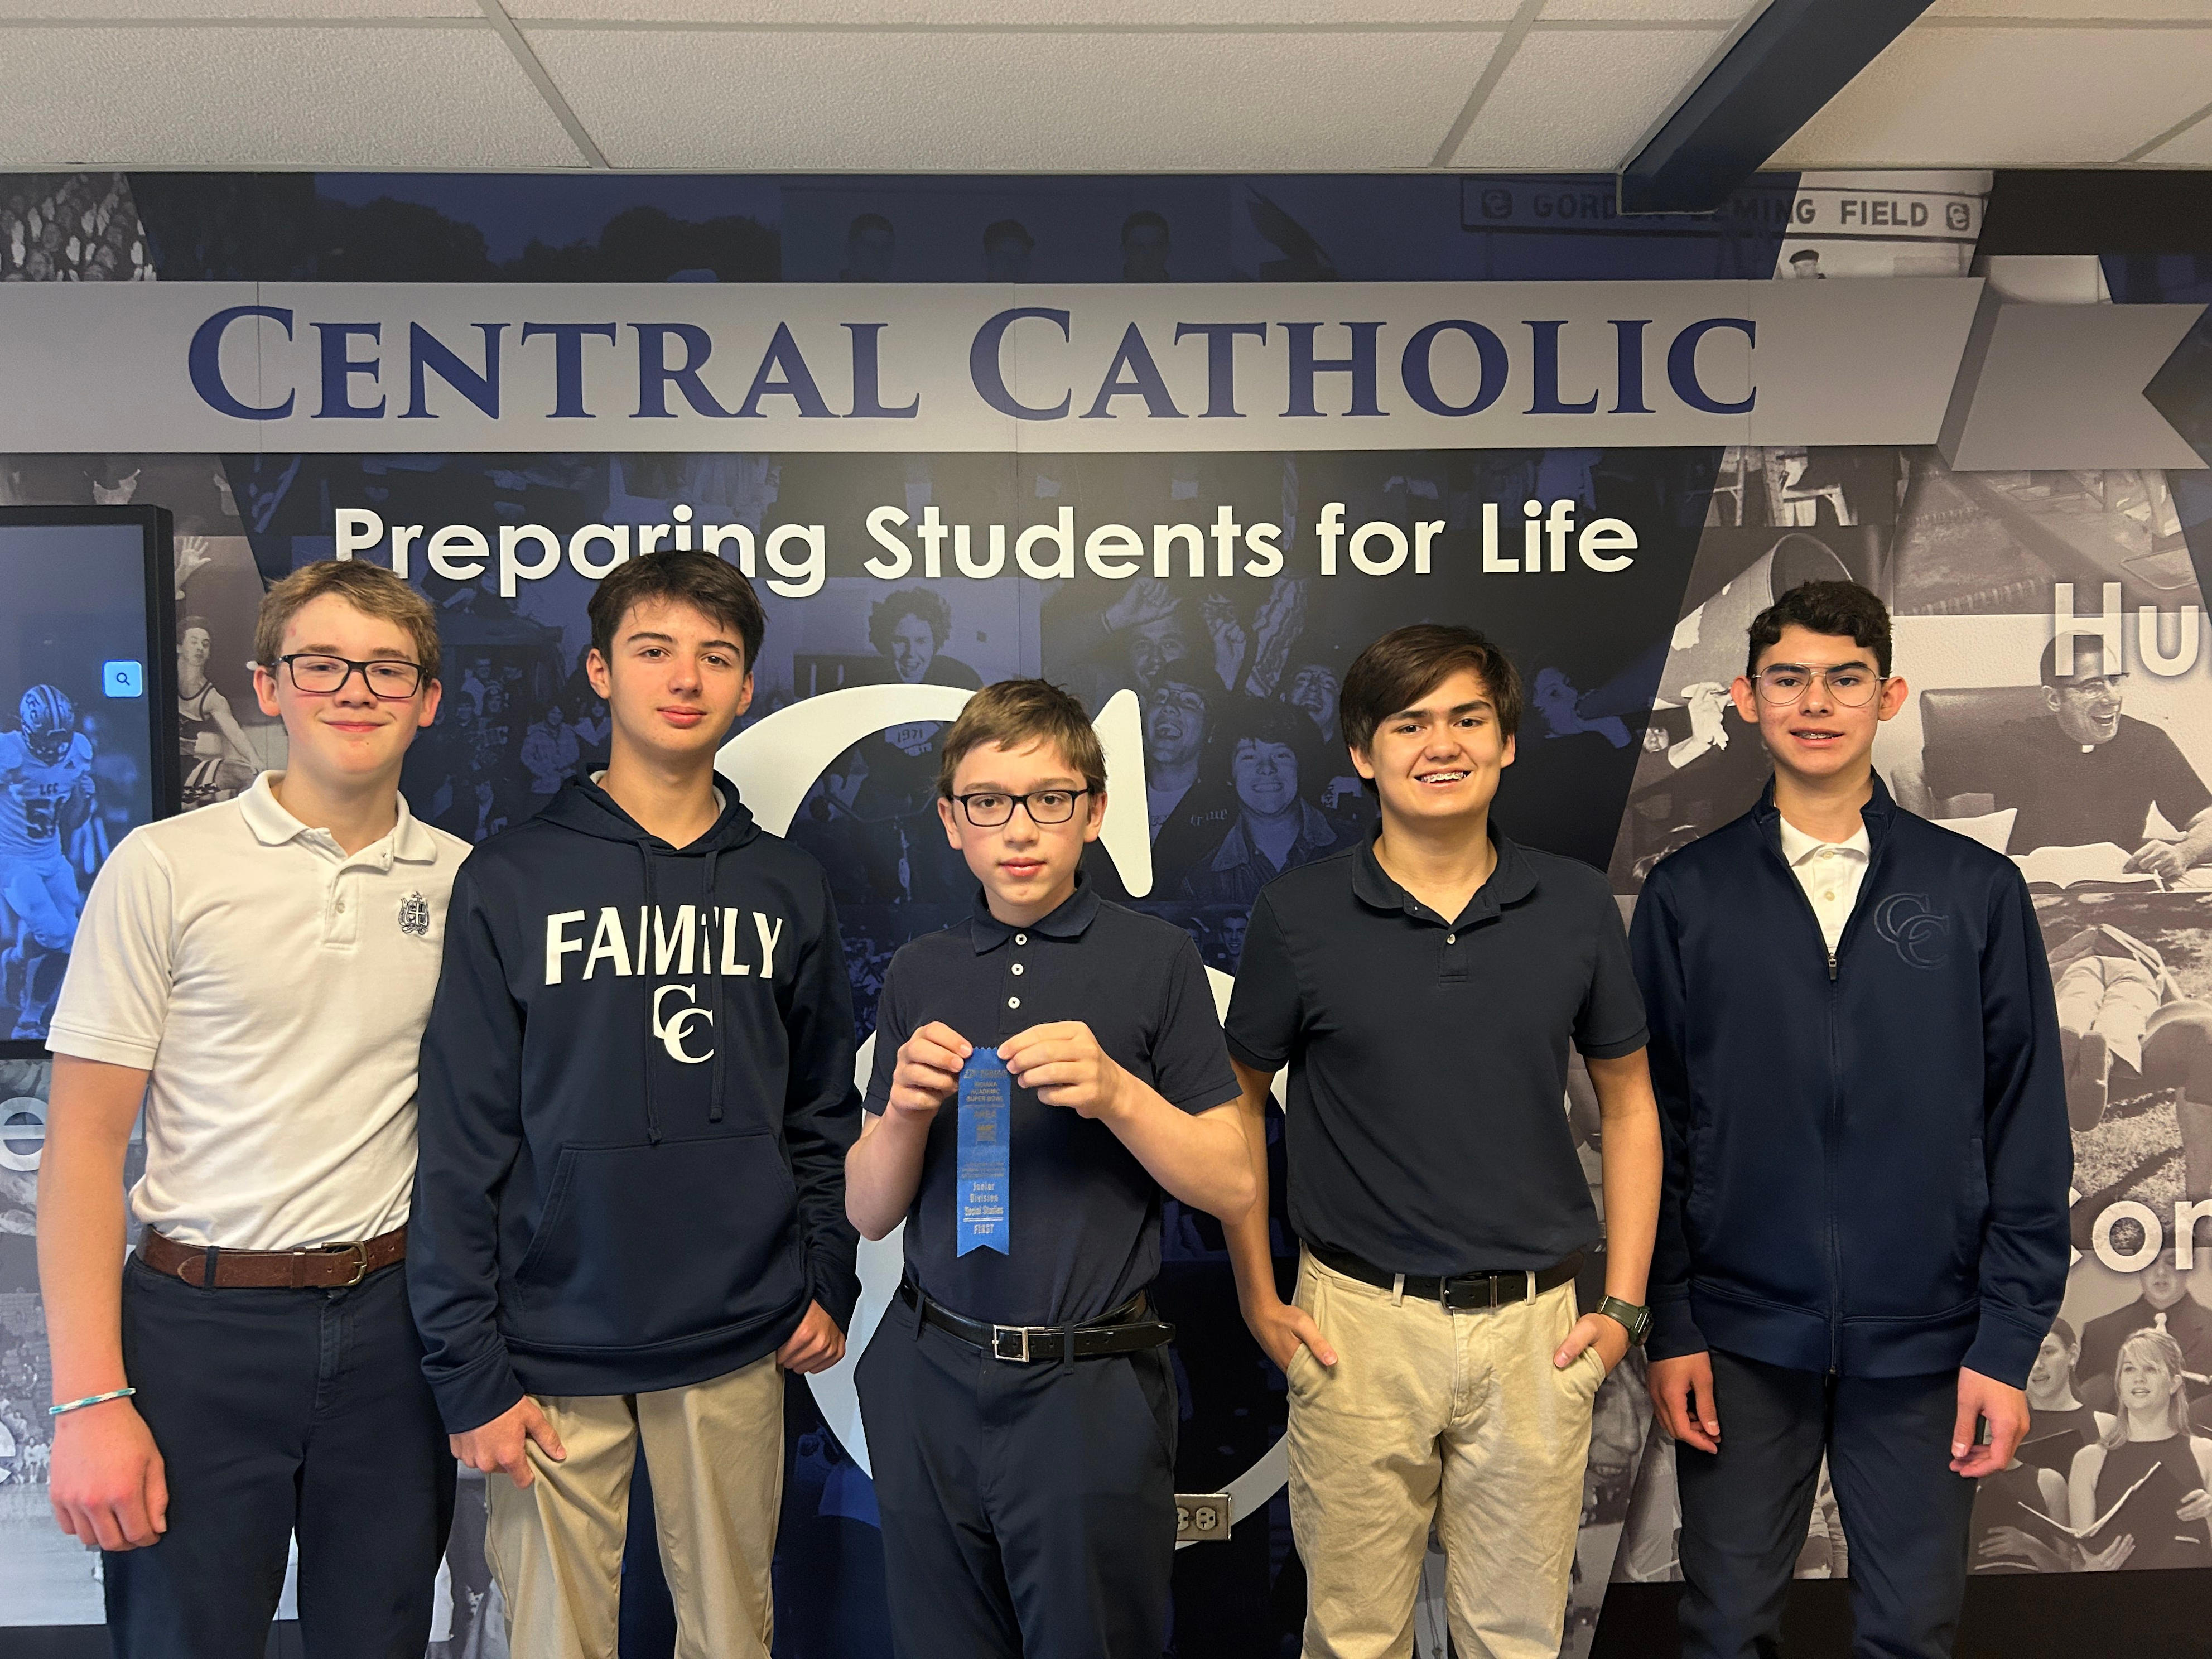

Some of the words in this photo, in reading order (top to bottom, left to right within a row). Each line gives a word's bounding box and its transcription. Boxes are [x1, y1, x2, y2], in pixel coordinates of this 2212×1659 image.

[1533, 193, 1665, 220] GORD
[1840, 200, 1929, 226] FIELD
[189, 305, 919, 421] CENTRAL
[970, 305, 1757, 419] CATHOLIC
[335, 504, 826, 598] Preparing
[863, 505, 1284, 580] Students
[1315, 501, 1446, 576] for
[1482, 499, 1638, 573] Life
[898, 729, 923, 743] 1971
[973, 1181, 995, 1192] Junior
[970, 1193, 999, 1203] Division
[964, 1206, 982, 1216] Social
[982, 1205, 1004, 1215] Studies
[974, 1224, 994, 1234] FIRST
